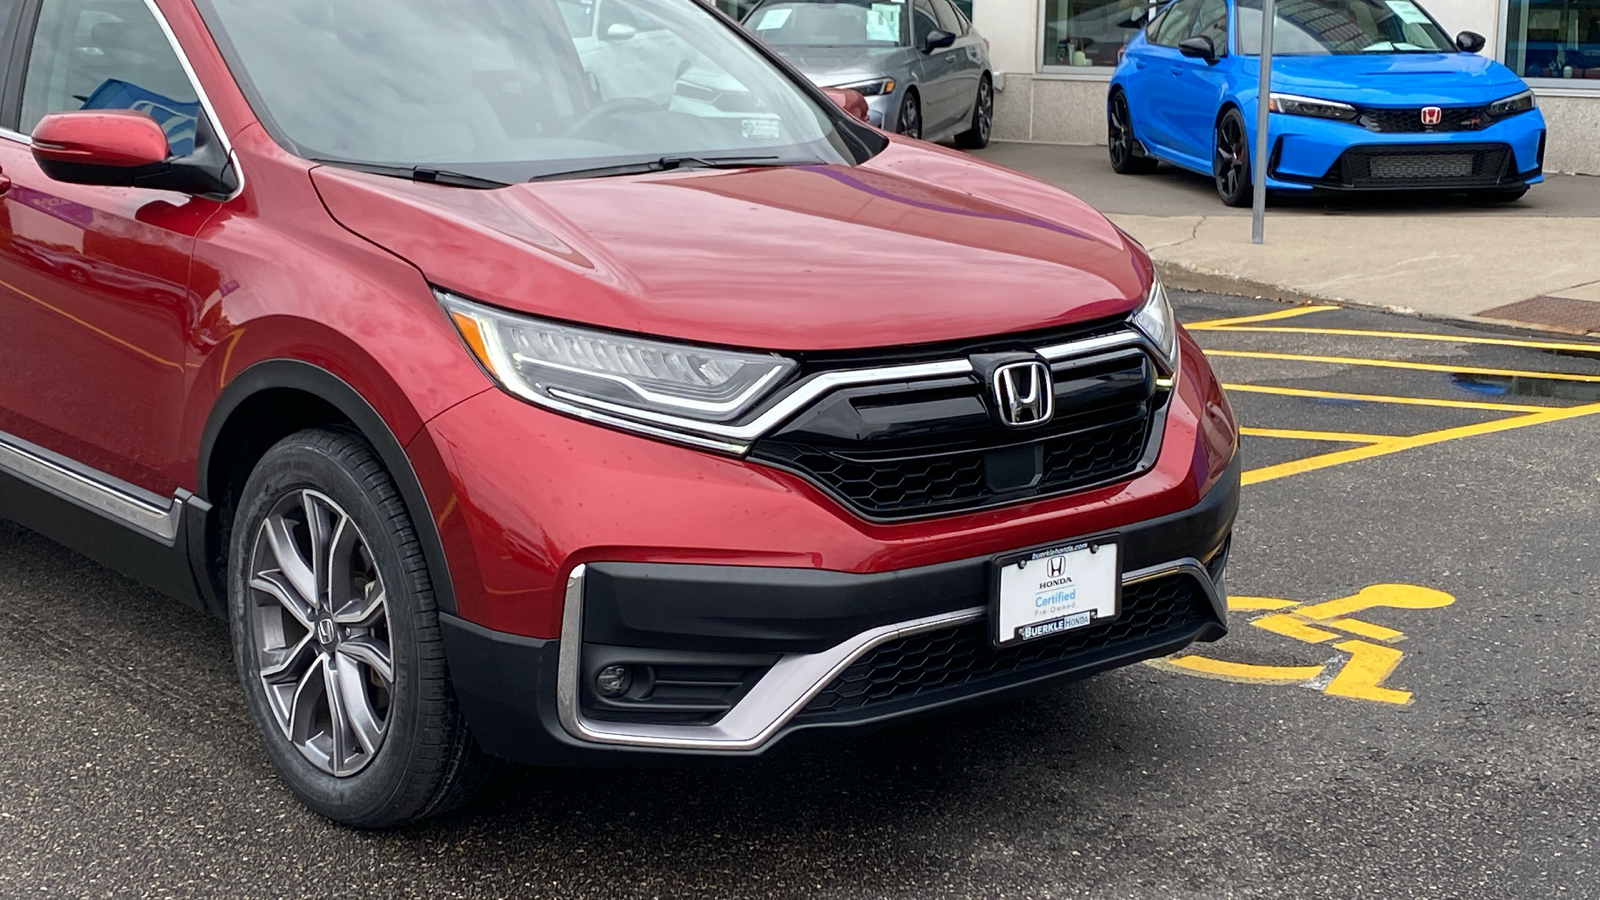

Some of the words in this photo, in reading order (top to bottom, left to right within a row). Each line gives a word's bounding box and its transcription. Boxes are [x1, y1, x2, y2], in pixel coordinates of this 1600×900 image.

[1039, 577, 1072, 589] HONDA
[1035, 589, 1076, 607] Certified
[1035, 601, 1076, 616] Pre-Owned
